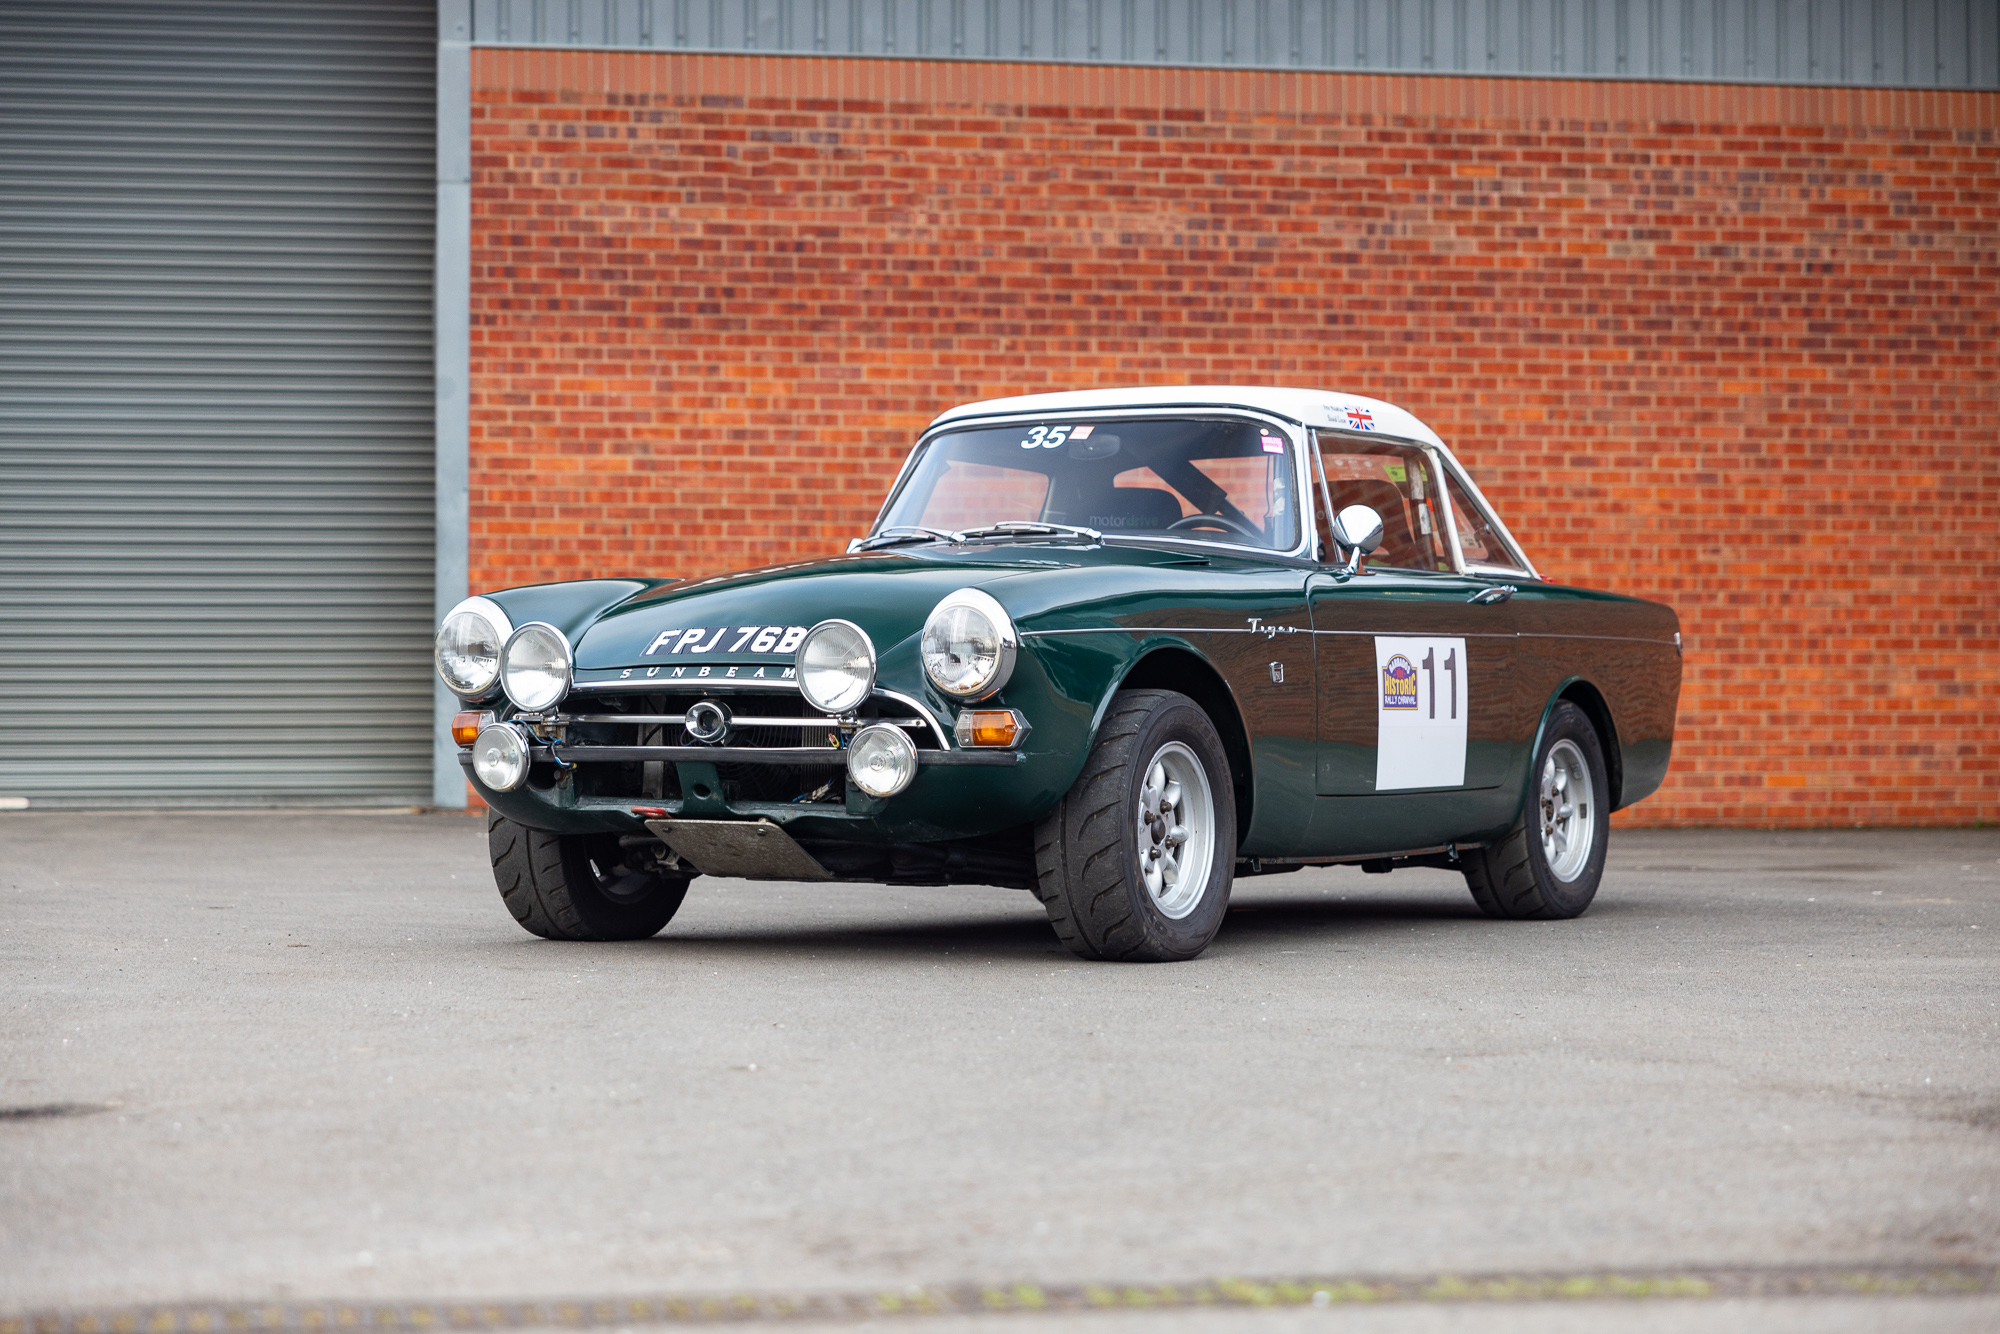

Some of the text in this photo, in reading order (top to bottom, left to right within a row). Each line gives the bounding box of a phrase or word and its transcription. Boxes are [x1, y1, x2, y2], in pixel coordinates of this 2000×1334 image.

[1020, 425, 1072, 450] 35
[1089, 514, 1159, 527] motordrive
[645, 626, 809, 655] FPJ 76B
[619, 666, 797, 679] SUNBEAM
[1384, 671, 1416, 696] HISTORIC
[1422, 646, 1457, 720] 11
